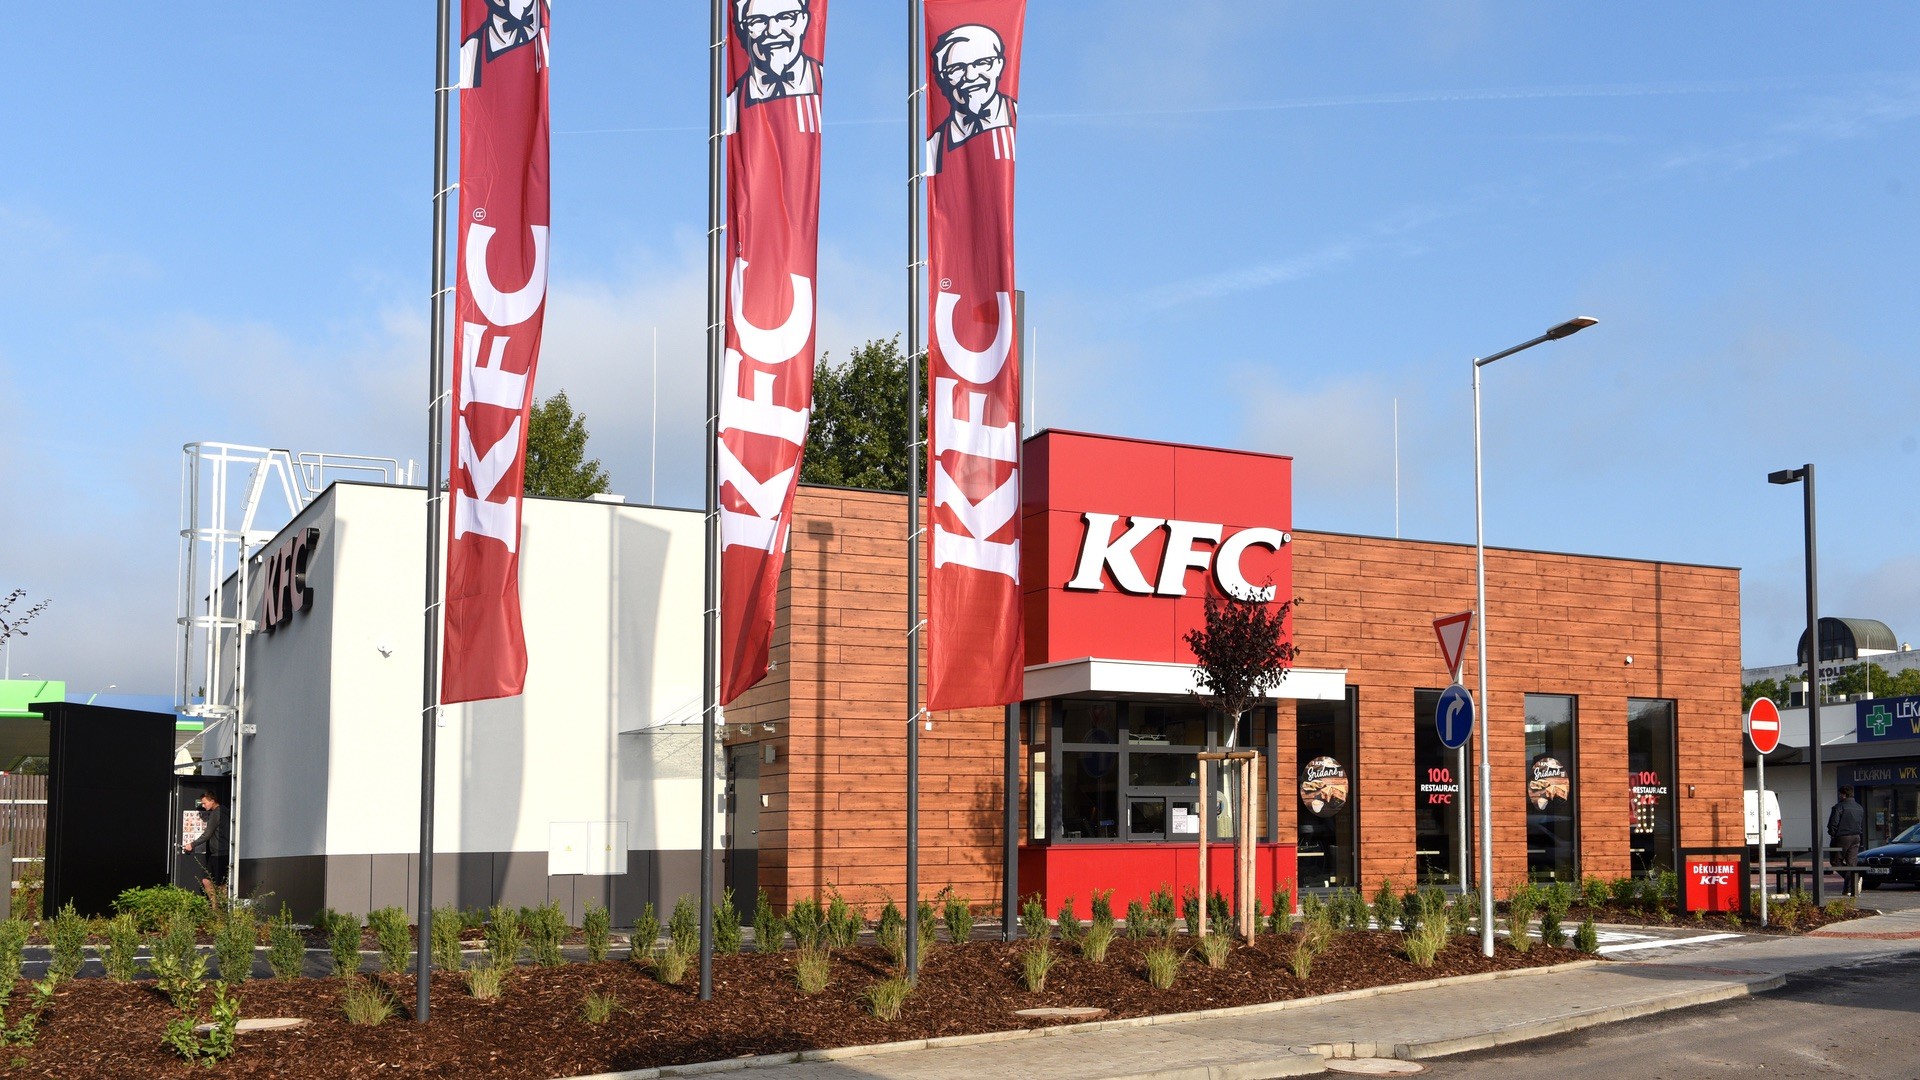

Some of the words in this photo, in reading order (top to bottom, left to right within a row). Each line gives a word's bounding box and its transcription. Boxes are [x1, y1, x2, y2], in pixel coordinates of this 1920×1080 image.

[260, 527, 319, 634] KFC
[1428, 768, 1453, 783] 100.
[1638, 771, 1661, 785] 100.
[1899, 767, 1918, 780] WPK
[1632, 786, 1667, 794] RESTAURACE
[1428, 793, 1452, 804] KFC
[1693, 863, 1734, 874] DĚKUJEME
[1700, 875, 1729, 885] KFC
